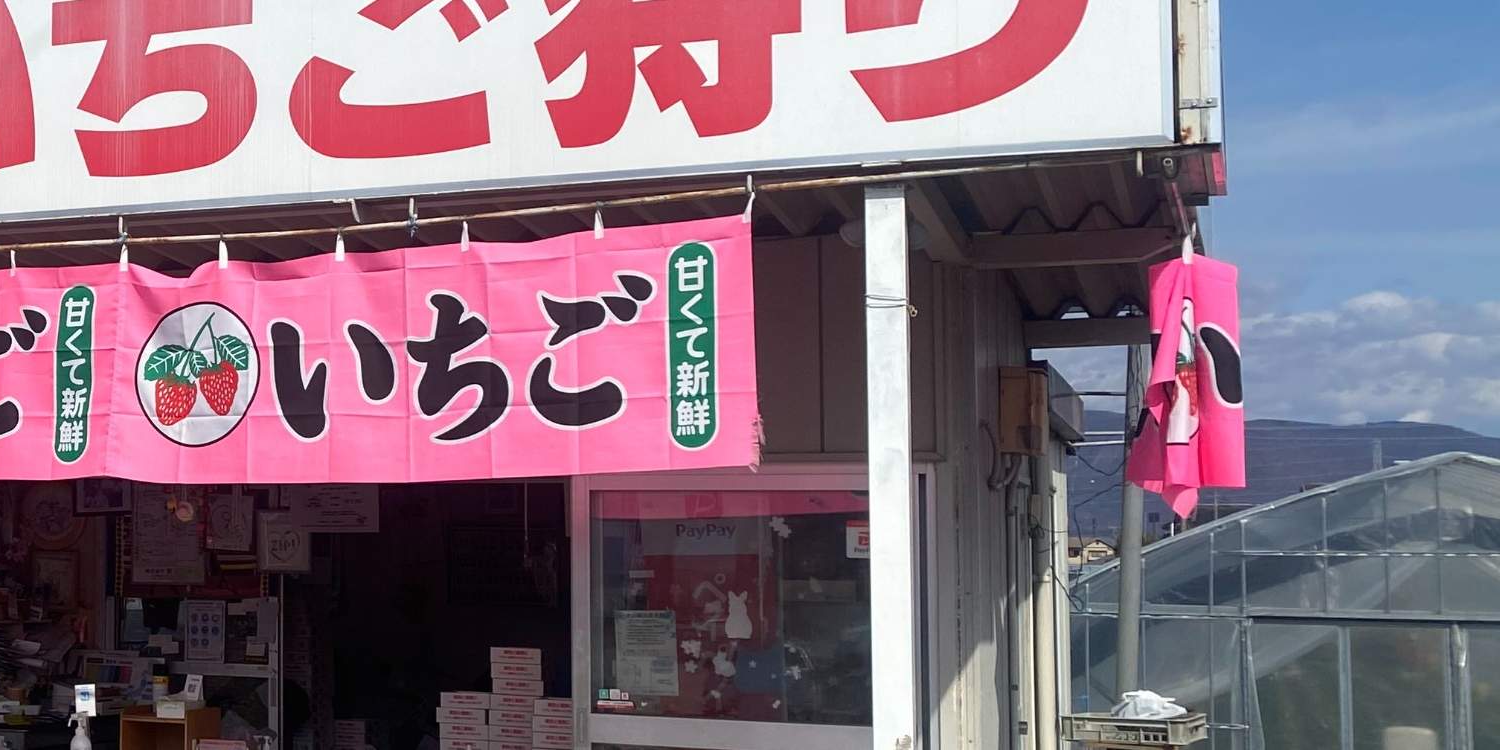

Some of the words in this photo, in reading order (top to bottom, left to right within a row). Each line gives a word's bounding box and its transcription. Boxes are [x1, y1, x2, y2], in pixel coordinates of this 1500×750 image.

[57, 299, 91, 452] 甘くて新鮮
[269, 273, 654, 440] いちご
[674, 254, 709, 436] 甘くて新鮮
[675, 523, 736, 540] PayPay
